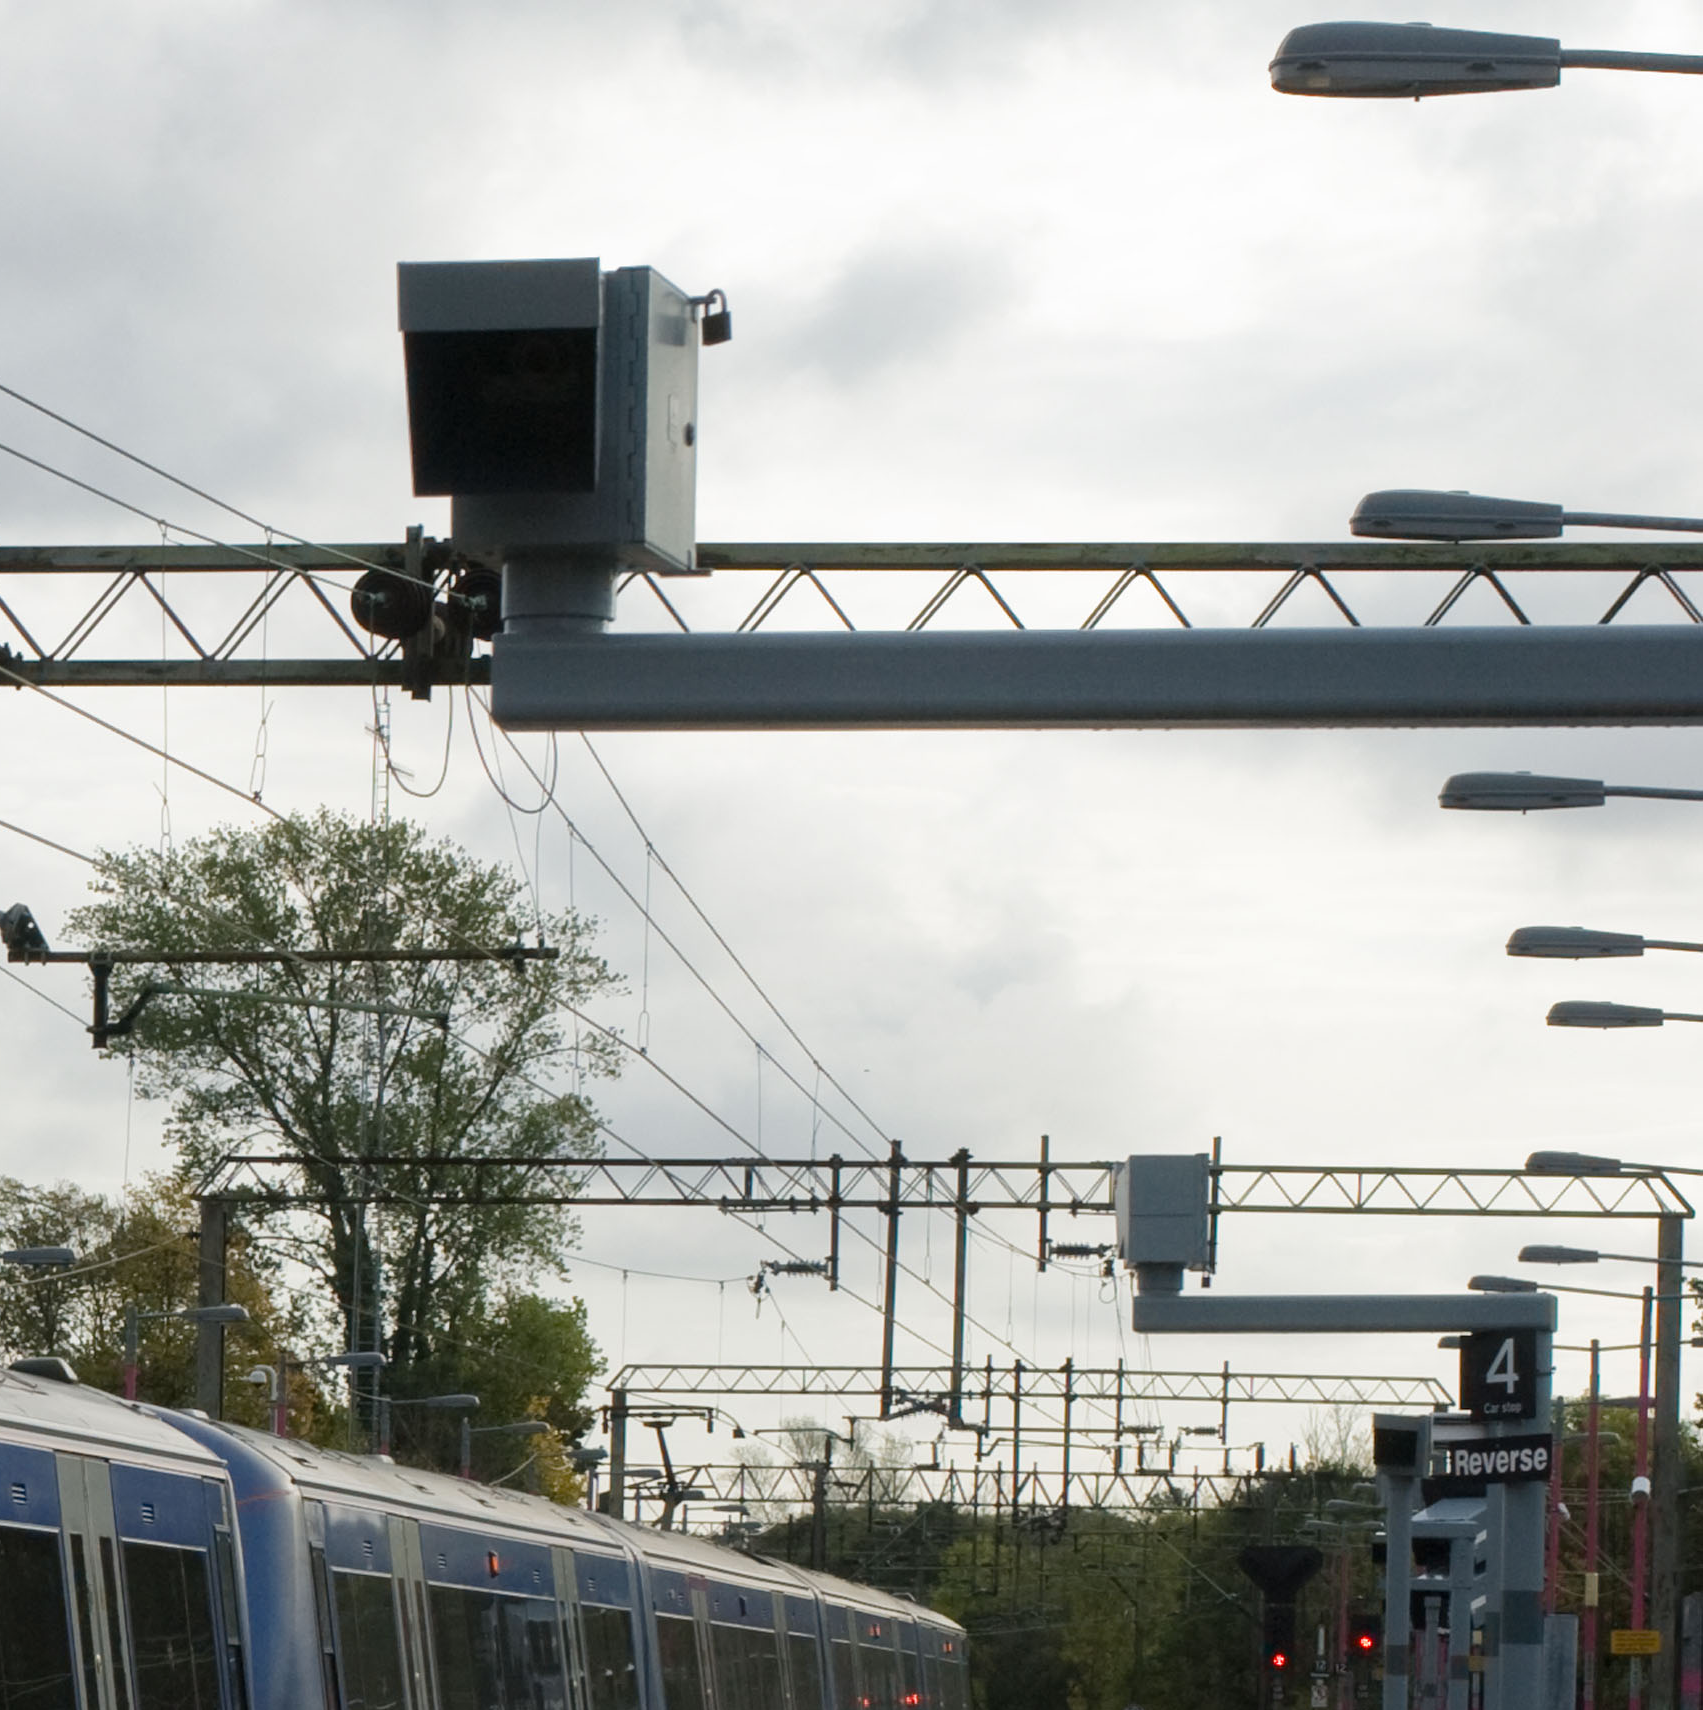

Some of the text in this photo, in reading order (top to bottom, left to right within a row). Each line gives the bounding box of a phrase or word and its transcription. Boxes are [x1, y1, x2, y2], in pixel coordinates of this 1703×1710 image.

[1486, 1338, 1519, 1394] 4
[1483, 1402, 1523, 1416] Car stop
[1455, 1446, 1548, 1476] Reverse
